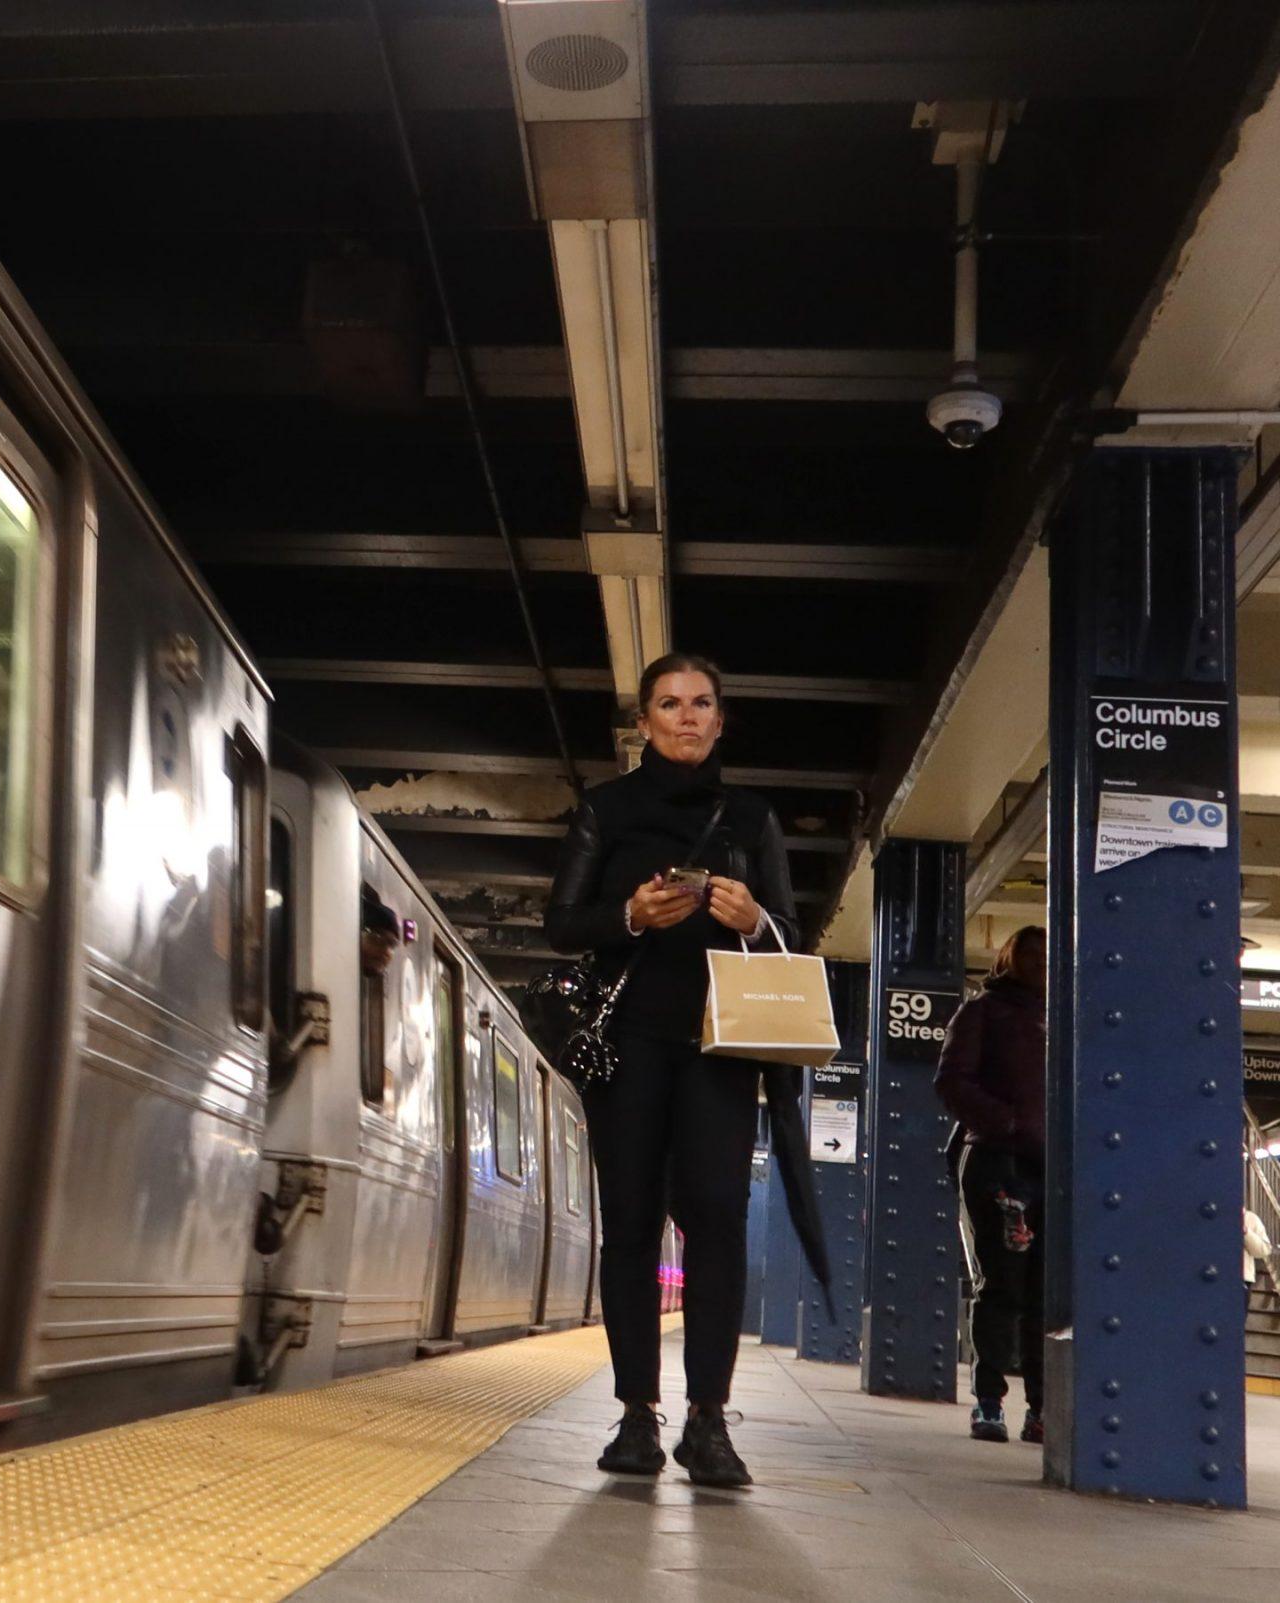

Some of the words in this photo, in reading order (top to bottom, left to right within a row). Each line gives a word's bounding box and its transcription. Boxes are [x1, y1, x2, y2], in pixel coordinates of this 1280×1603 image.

[1095, 702, 1221, 728] Columbus
[1095, 728, 1167, 751] Circle
[1175, 806, 1189, 820] A
[1204, 808, 1218, 823] C
[1100, 834, 1153, 847] Downtown
[1100, 846, 1126, 857] arrive
[888, 992, 932, 1021] 59
[888, 1019, 948, 1041] Stree
[814, 1072, 841, 1083] Circle
